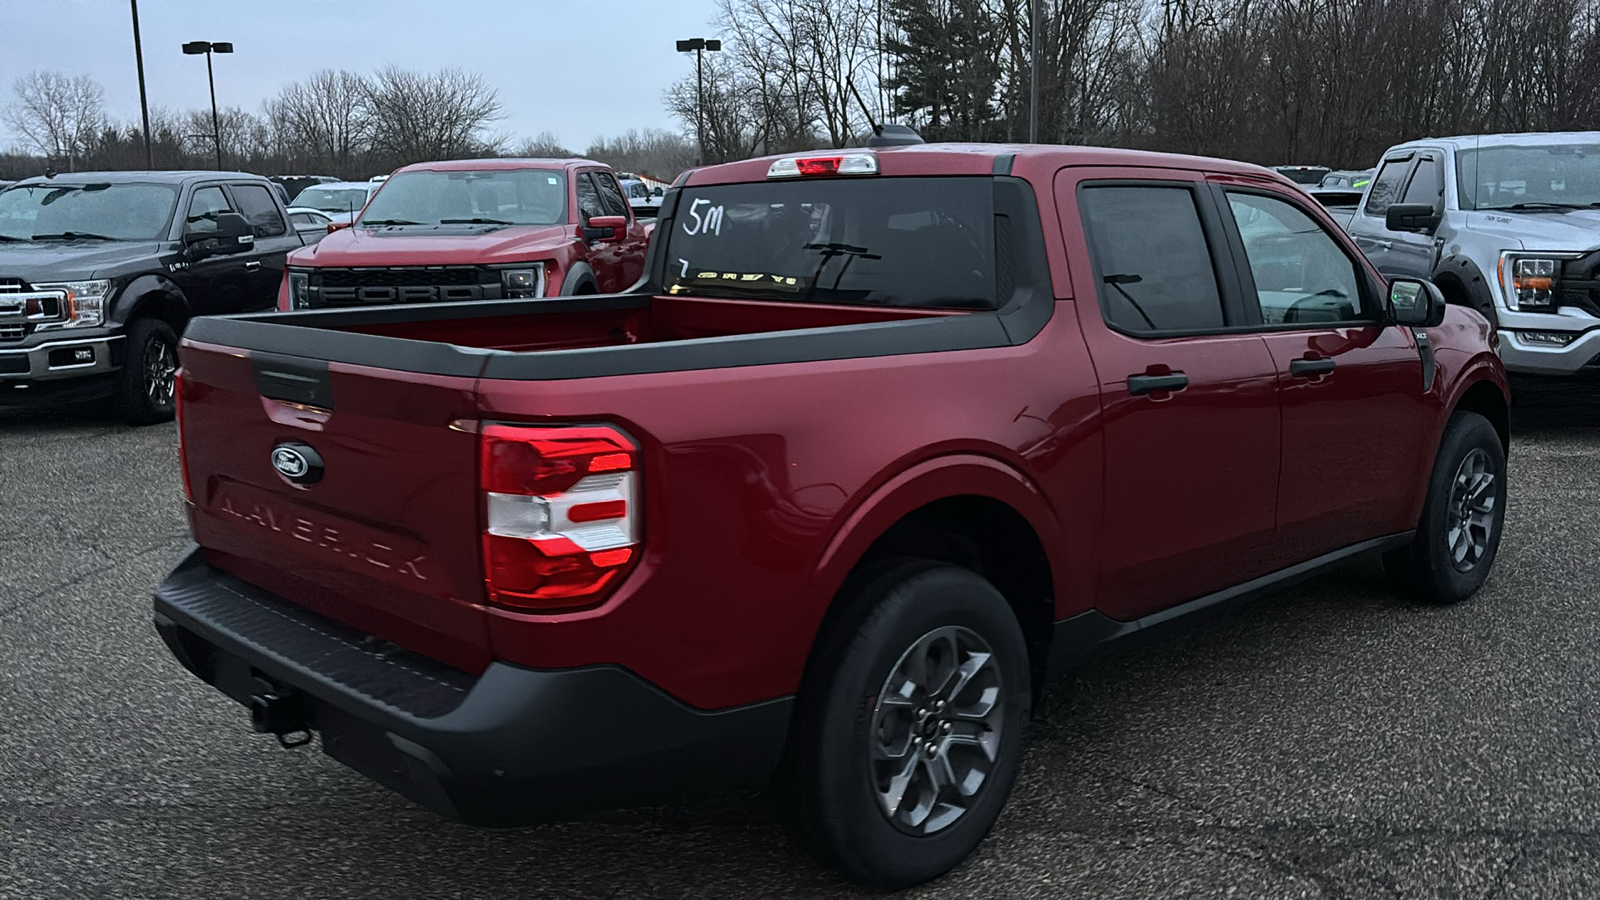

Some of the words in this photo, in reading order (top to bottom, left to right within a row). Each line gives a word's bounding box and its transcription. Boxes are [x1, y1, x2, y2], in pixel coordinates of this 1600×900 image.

[683, 198, 723, 235] 5M
[319, 285, 482, 307] FORD
[277, 451, 300, 473] Ford
